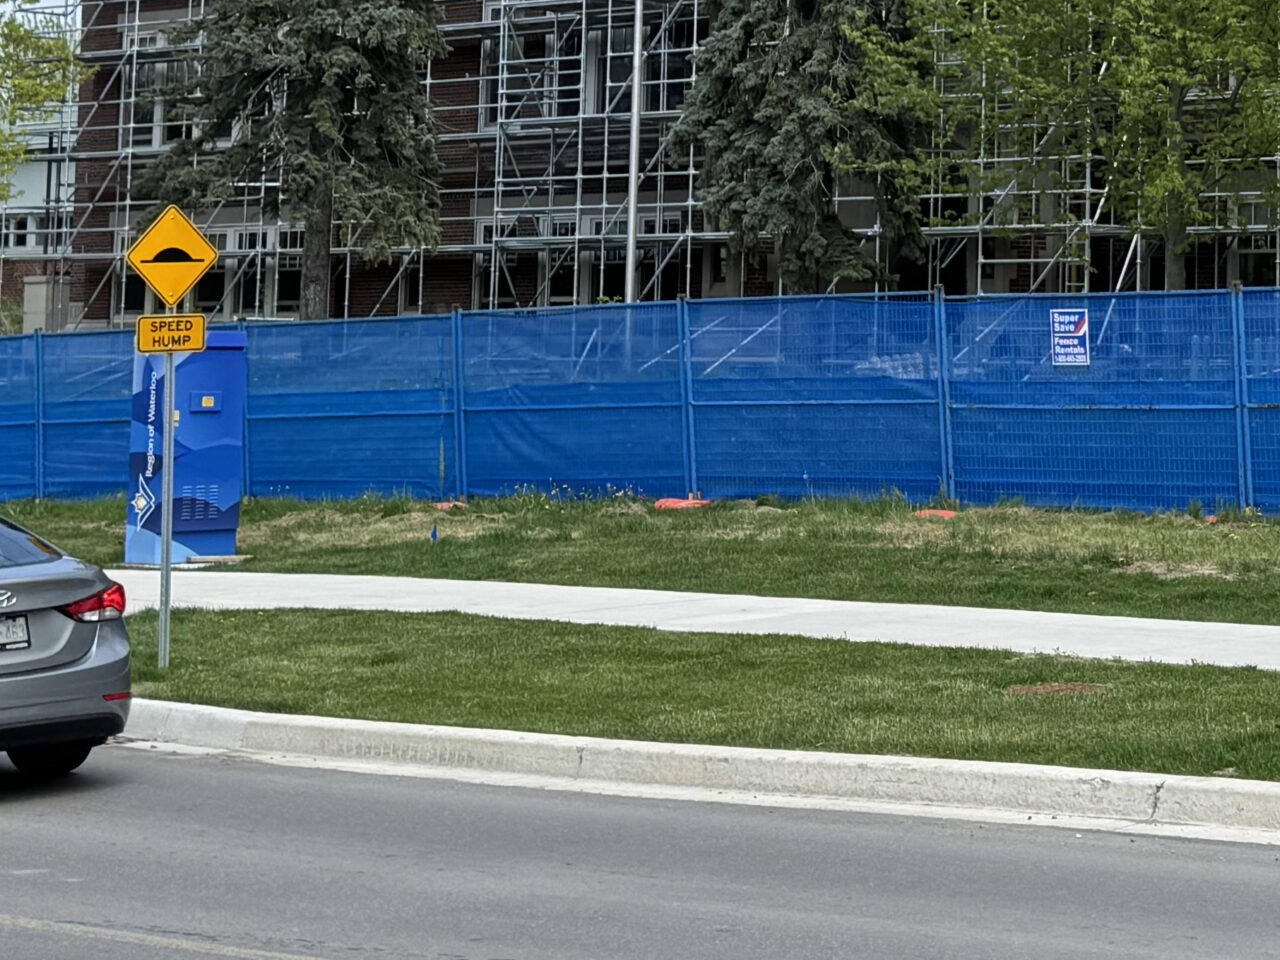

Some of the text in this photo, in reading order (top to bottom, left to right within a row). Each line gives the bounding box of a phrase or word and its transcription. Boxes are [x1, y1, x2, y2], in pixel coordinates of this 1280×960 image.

[1053, 312, 1079, 324] Super
[150, 320, 194, 333] SPEED
[1053, 322, 1075, 332] Save
[152, 334, 192, 348] HUMP
[1054, 336, 1079, 346] Fence
[1055, 345, 1086, 354] Rentals
[145, 371, 158, 478] Region of Waterloo
